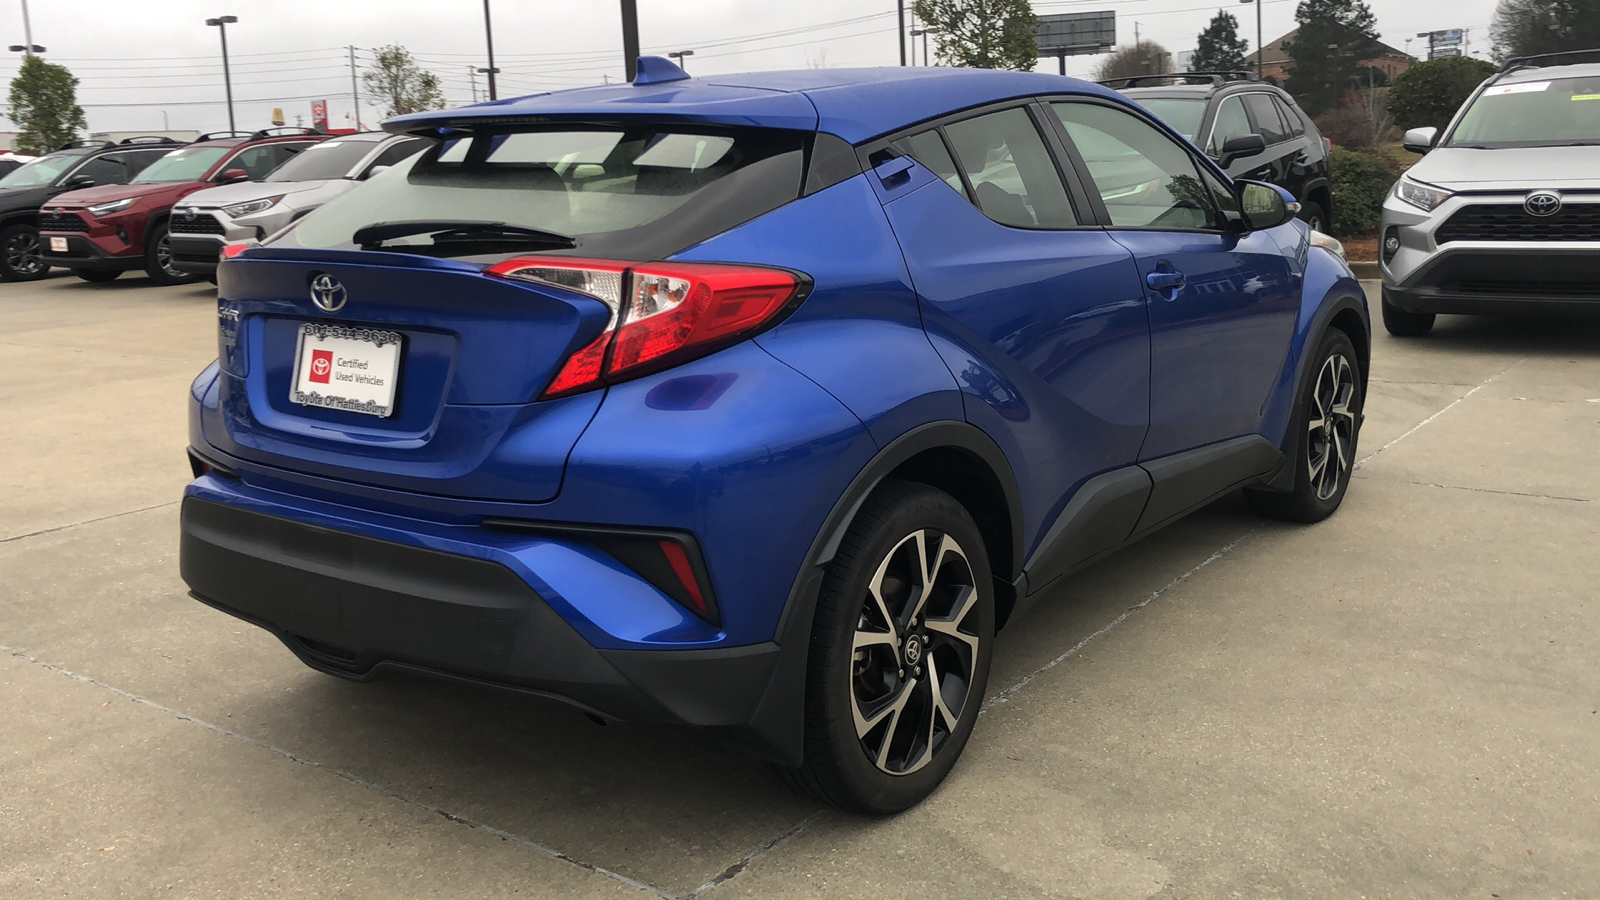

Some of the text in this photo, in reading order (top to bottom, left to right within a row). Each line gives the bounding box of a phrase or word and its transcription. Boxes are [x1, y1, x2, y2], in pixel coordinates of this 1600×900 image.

[303, 324, 398, 343] 601-544-9630
[337, 357, 369, 370] Certified
[335, 371, 385, 387] Used Vehicles
[295, 391, 323, 406] Toyota
[337, 398, 389, 417] Hattiesburg
